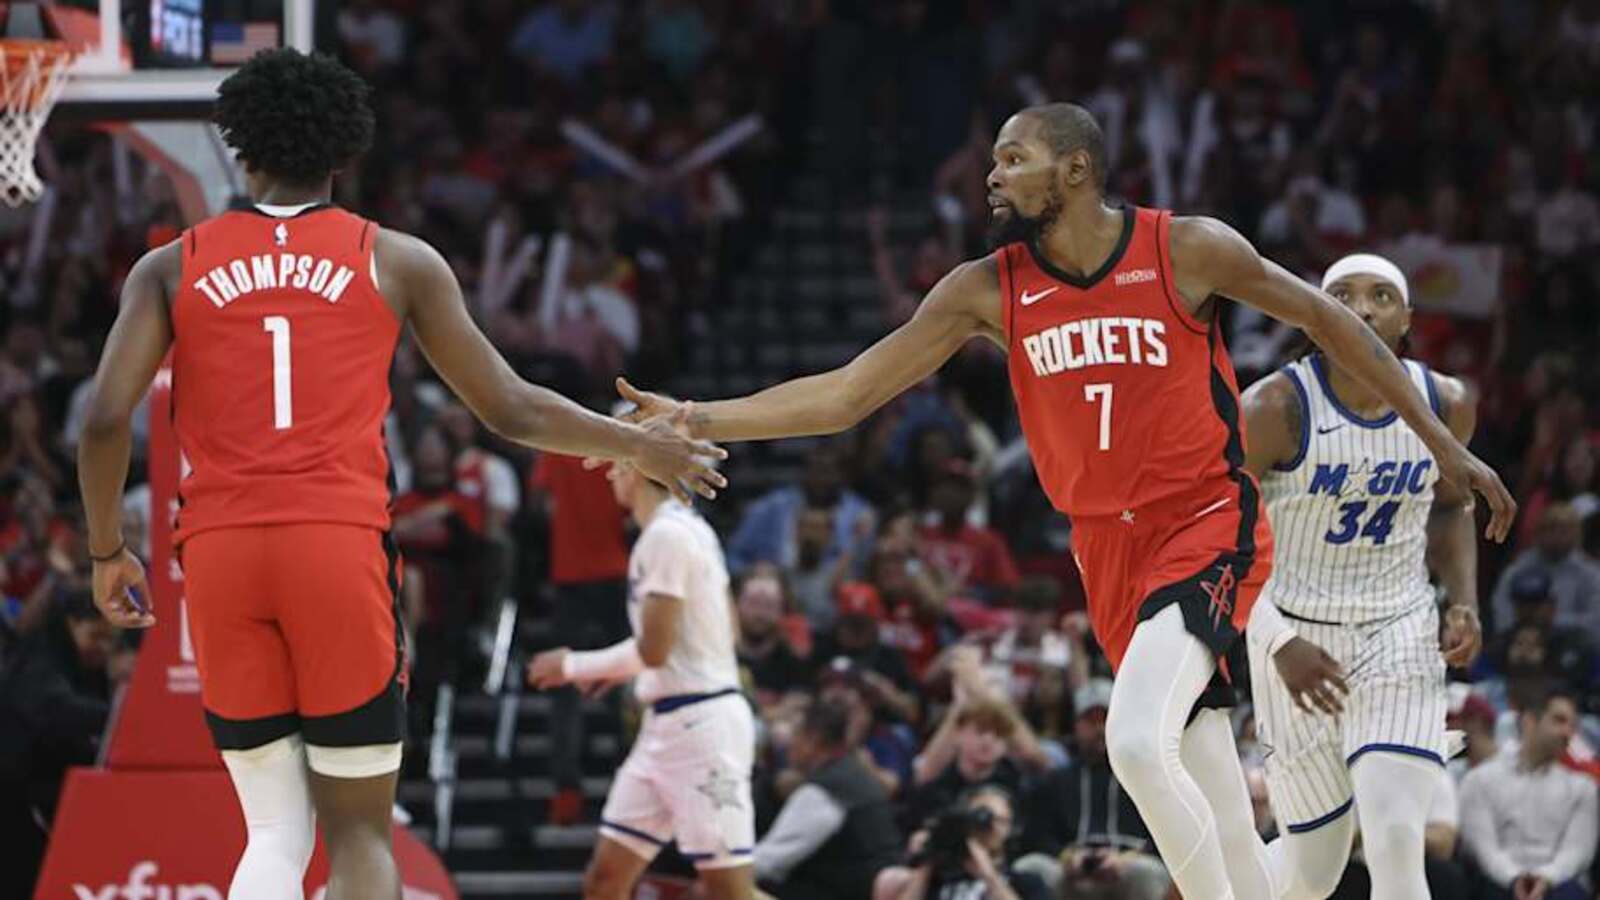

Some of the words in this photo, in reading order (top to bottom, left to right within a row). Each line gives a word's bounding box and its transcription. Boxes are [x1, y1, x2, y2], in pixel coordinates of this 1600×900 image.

[194, 253, 355, 309] THOMPSON
[263, 316, 293, 430] 1
[1022, 316, 1168, 377] ROCKETS
[1084, 383, 1113, 450] 7
[1324, 500, 1401, 545] 34
